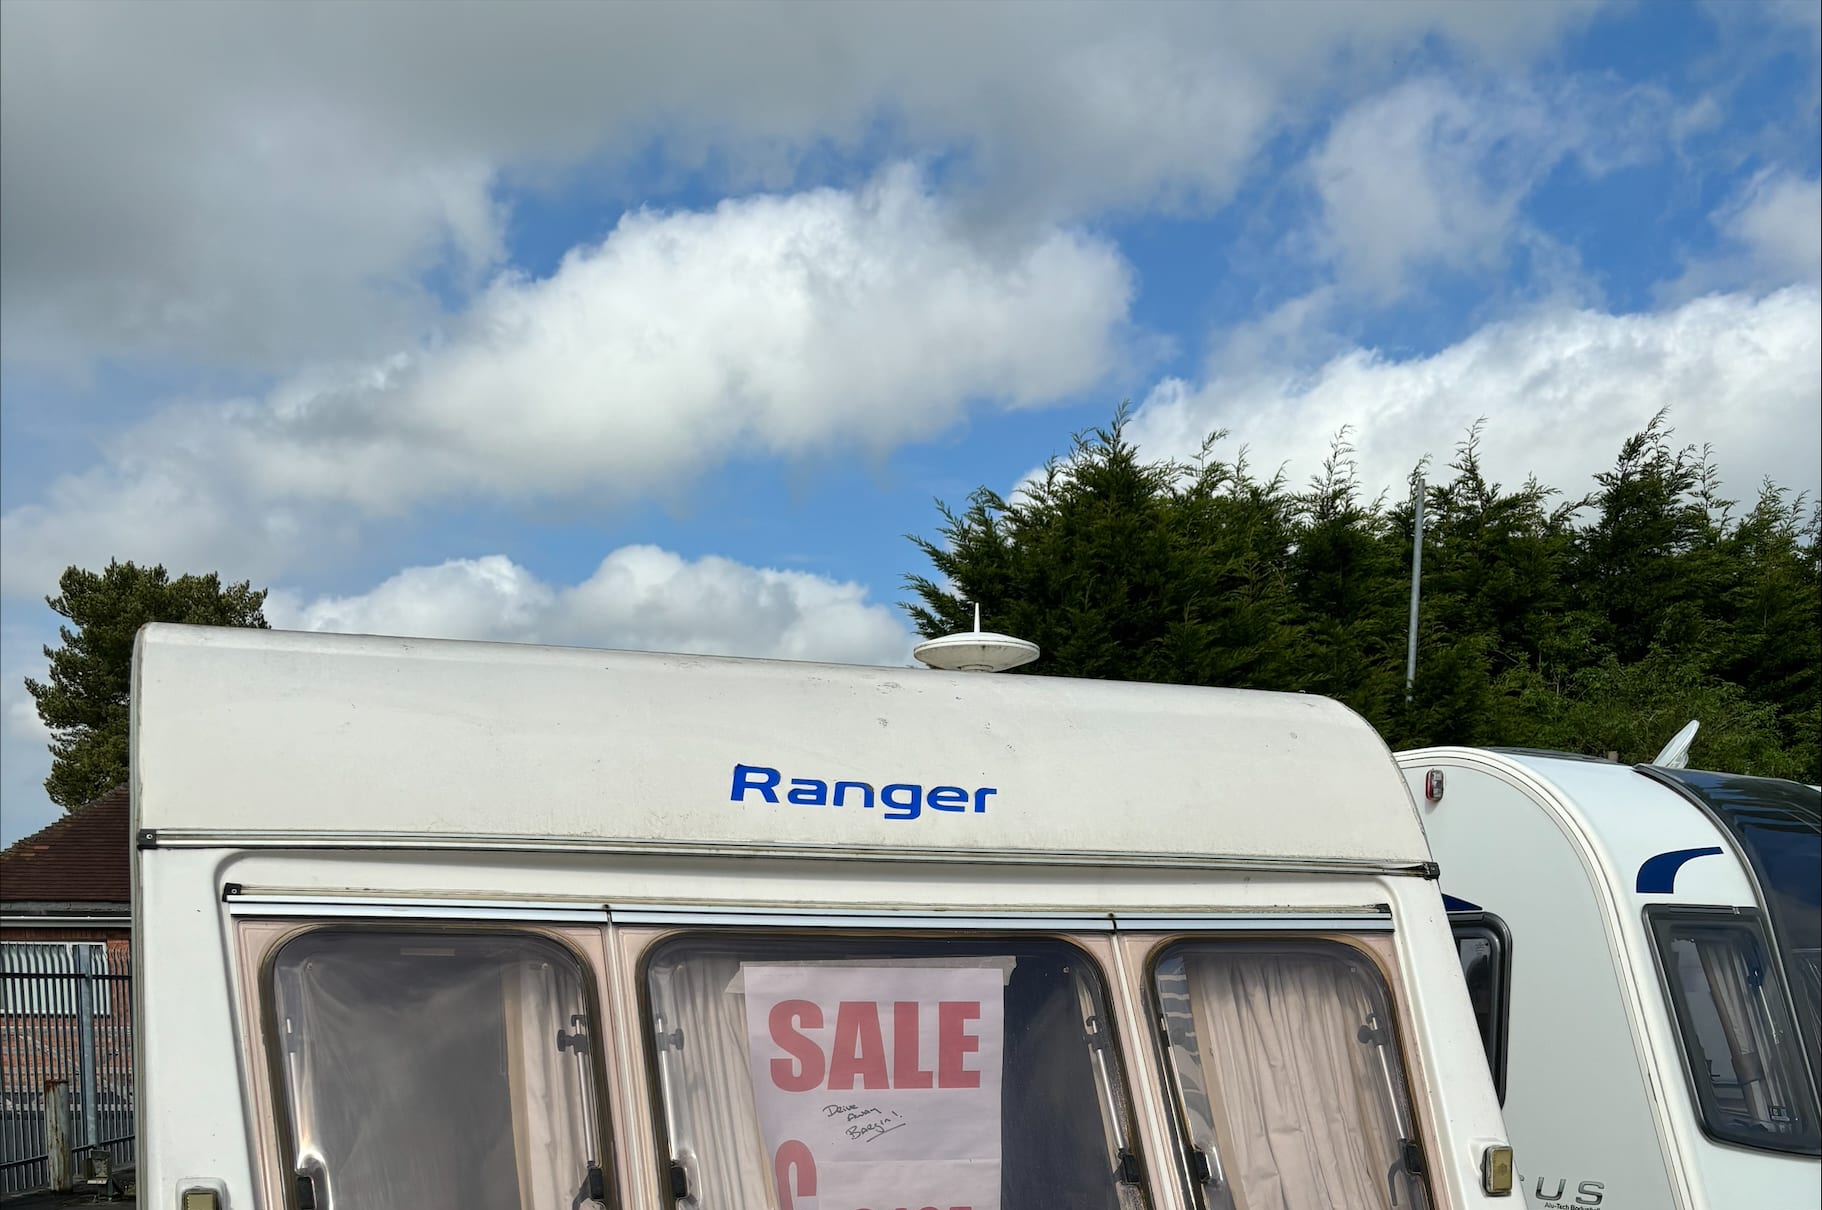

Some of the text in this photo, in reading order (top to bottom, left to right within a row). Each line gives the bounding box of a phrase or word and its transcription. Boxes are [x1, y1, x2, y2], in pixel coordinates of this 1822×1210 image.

[731, 764, 997, 820] Ranger
[768, 999, 981, 1093] SALE
[1520, 1174, 1605, 1206] US
